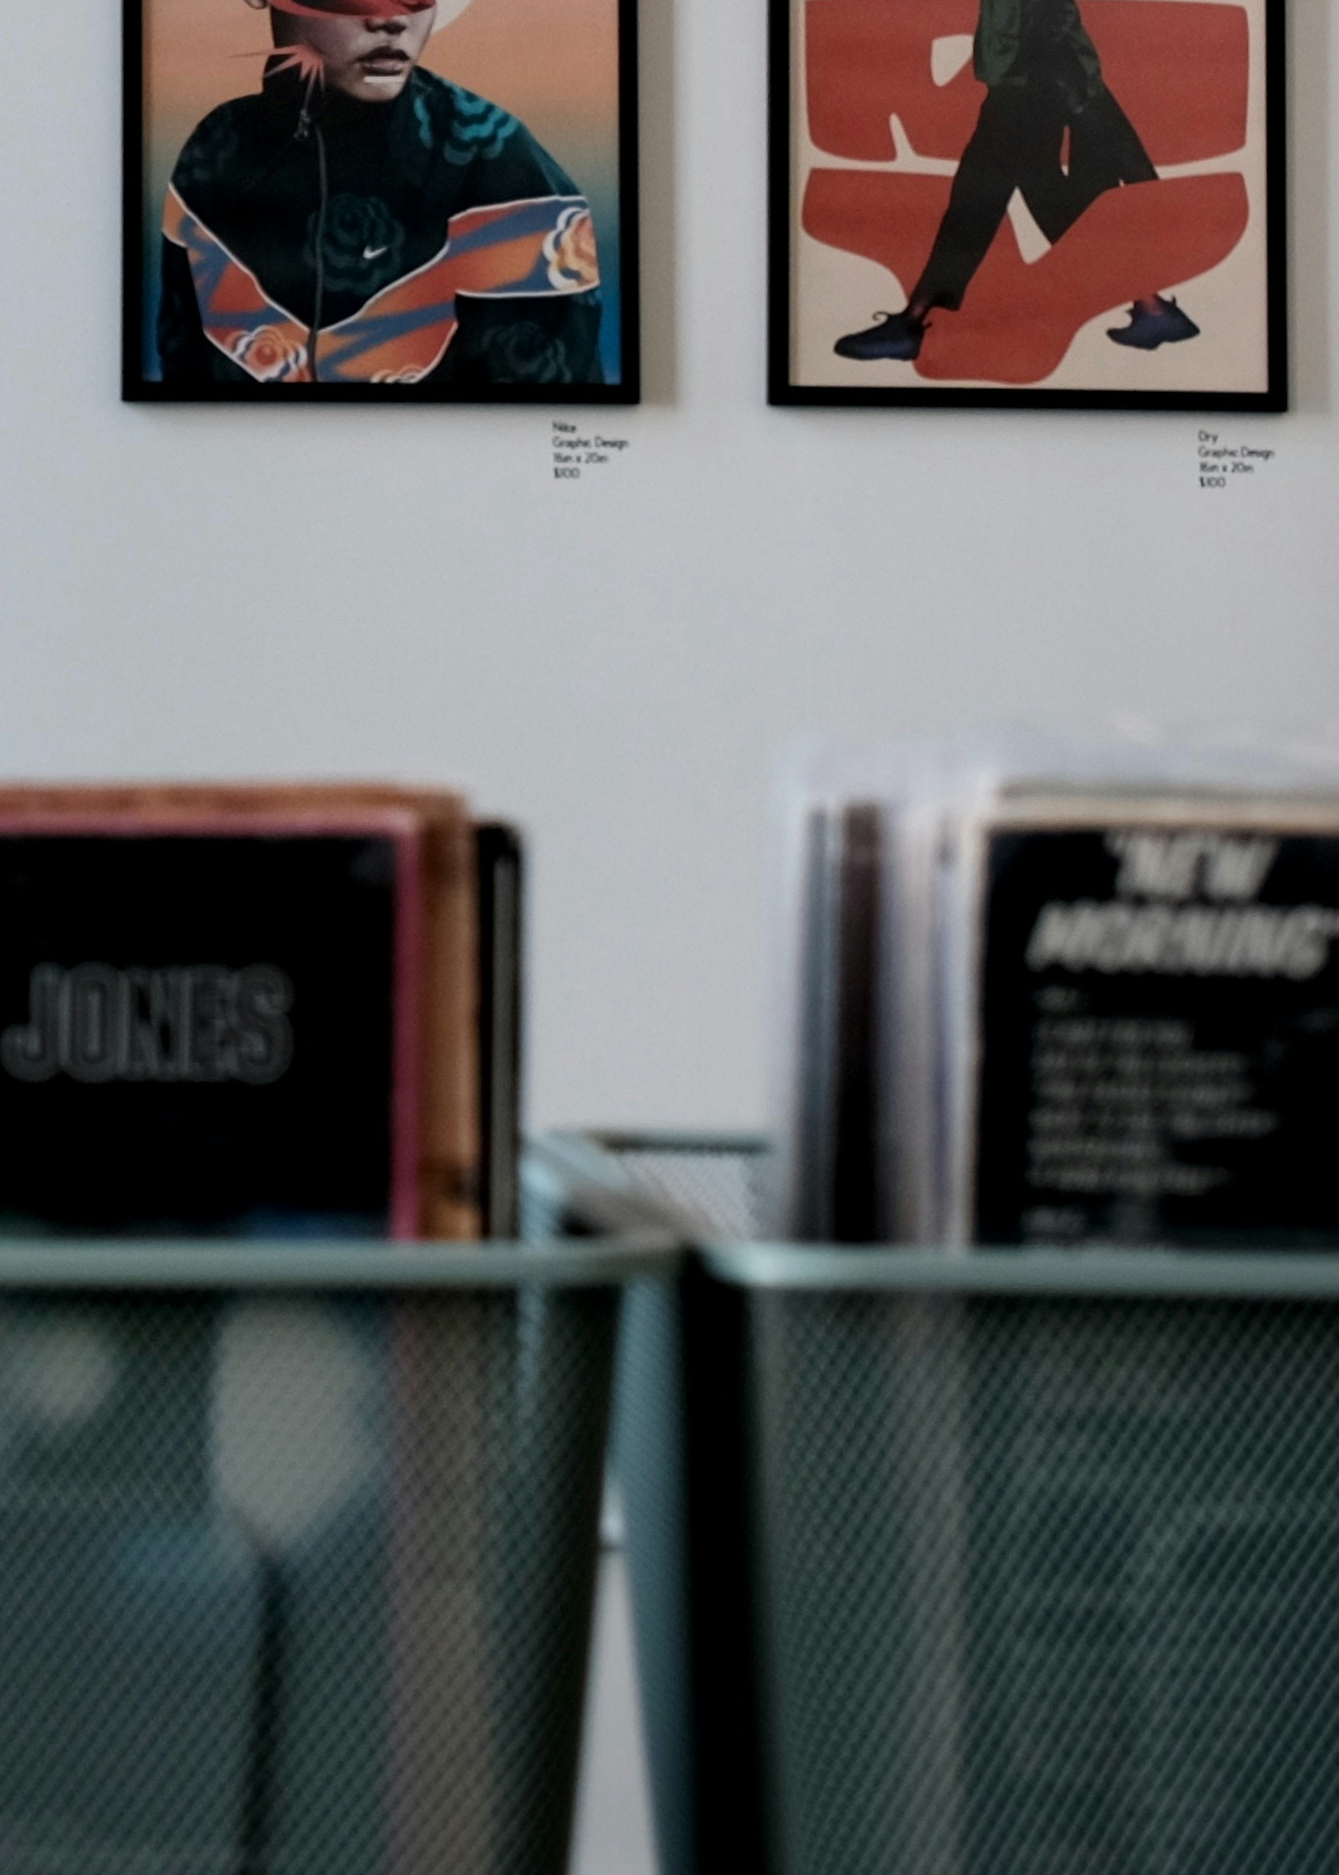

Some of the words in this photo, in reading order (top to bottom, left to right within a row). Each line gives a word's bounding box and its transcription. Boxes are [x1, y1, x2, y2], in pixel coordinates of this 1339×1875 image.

[594, 436, 629, 451] Design
[1199, 430, 1219, 445] Dry
[1241, 446, 1275, 462] Design
[0, 962, 294, 1082] JONES
